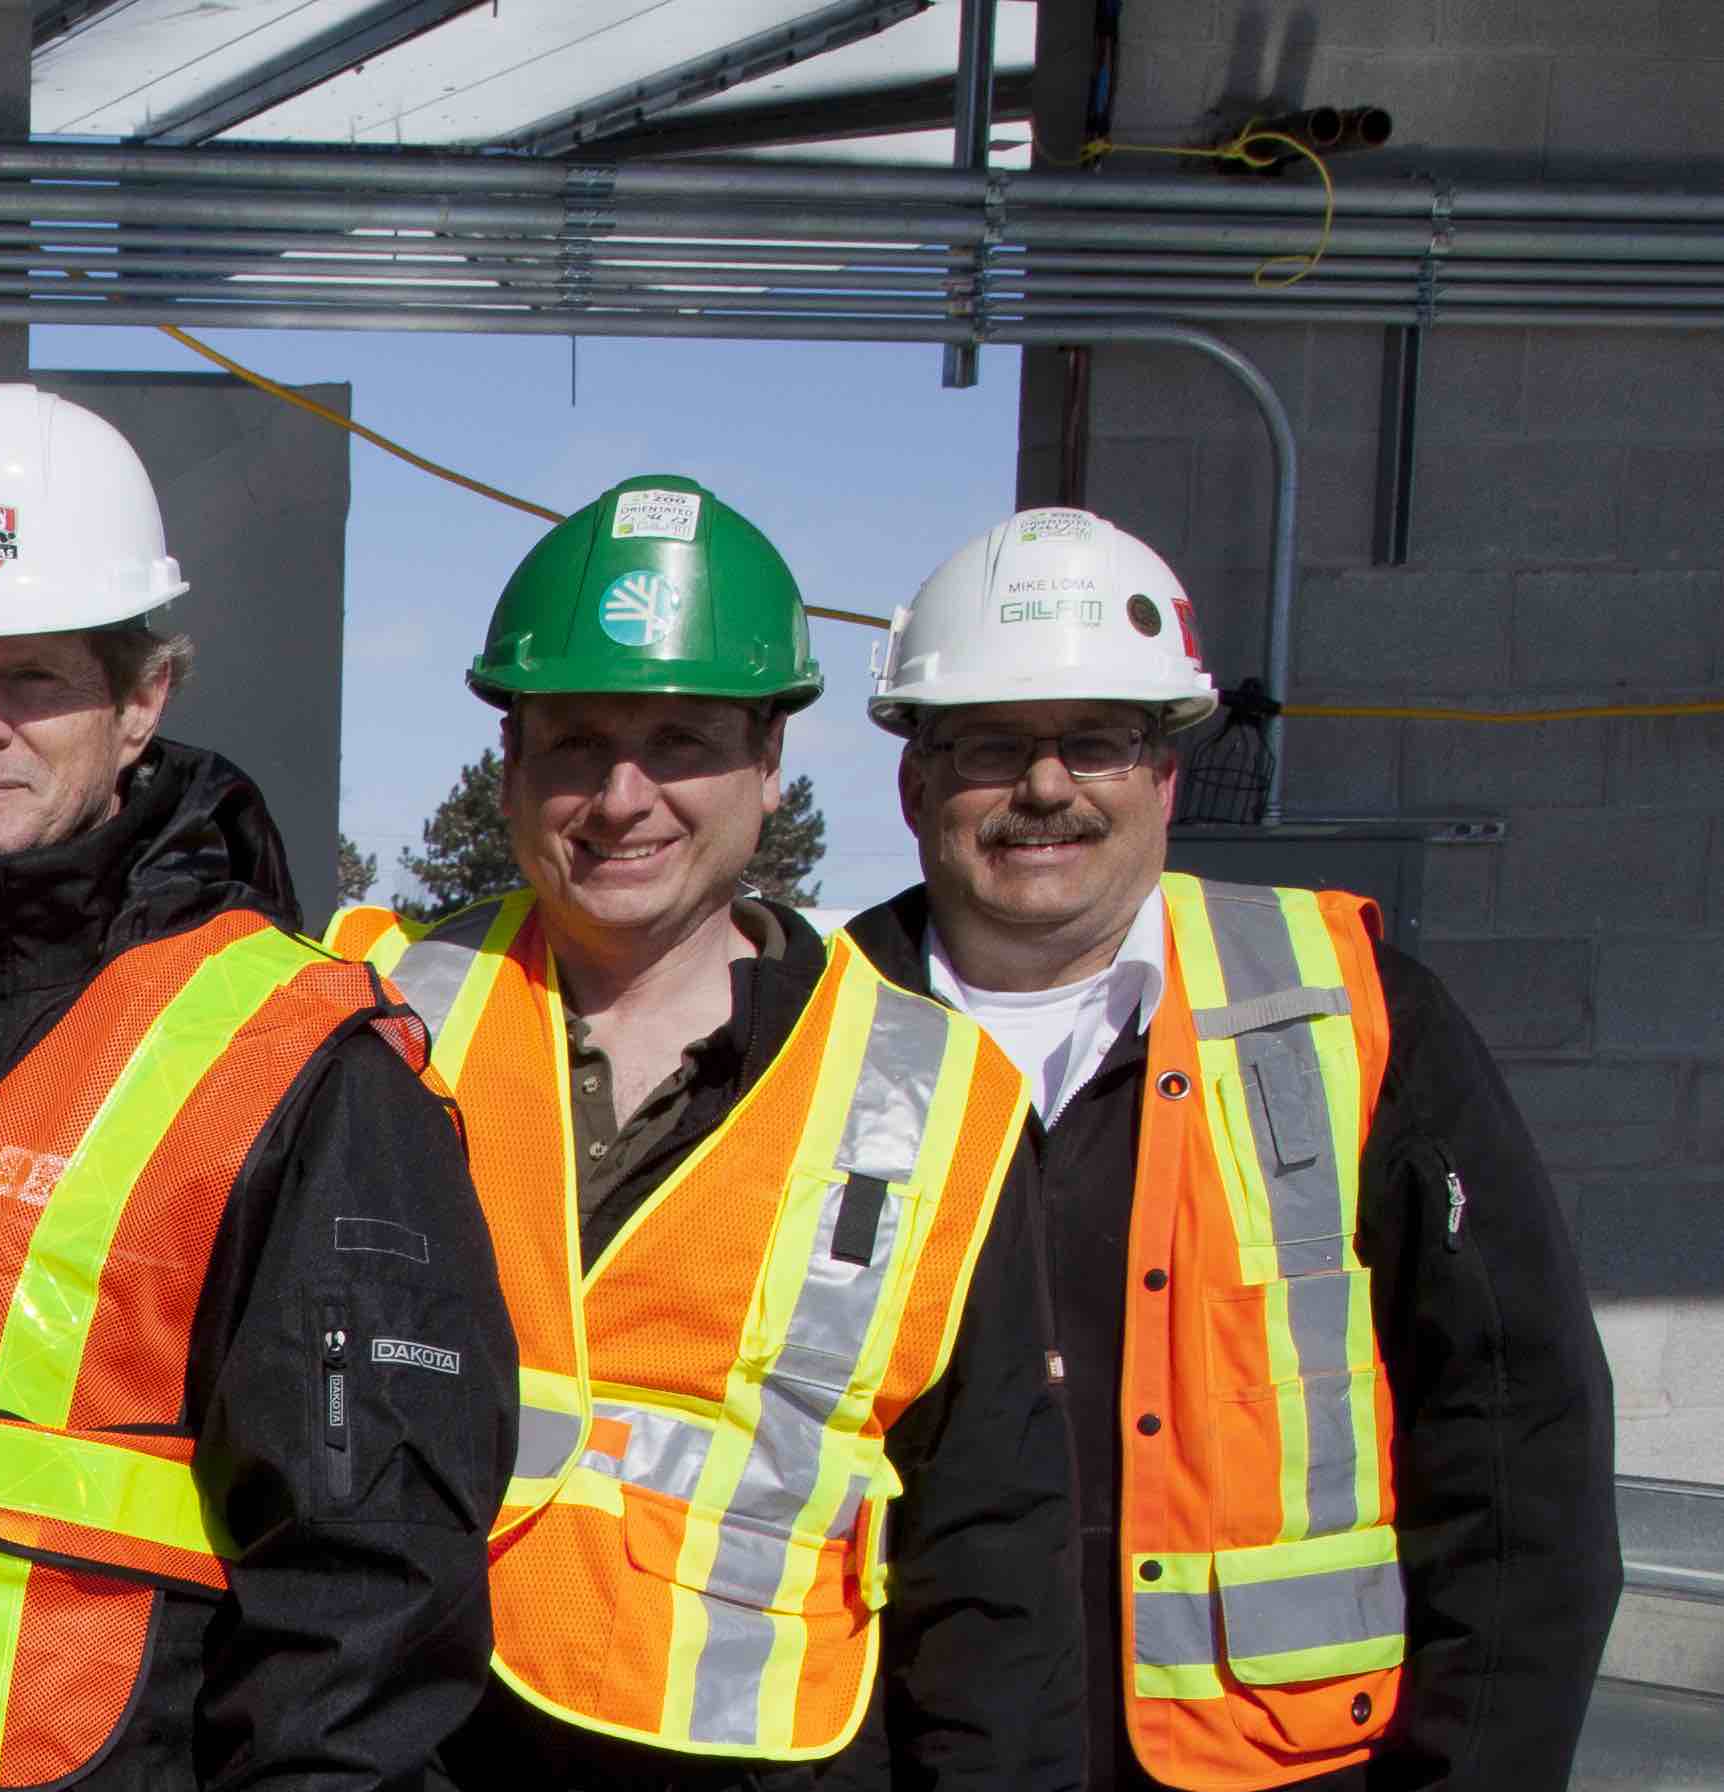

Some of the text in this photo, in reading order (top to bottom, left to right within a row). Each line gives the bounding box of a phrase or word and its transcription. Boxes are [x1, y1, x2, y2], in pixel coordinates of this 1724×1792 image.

[1008, 580, 1048, 593] MIKE
[376, 1343, 456, 1370] DAKOTA
[331, 1377, 342, 1423] DAKOTA
